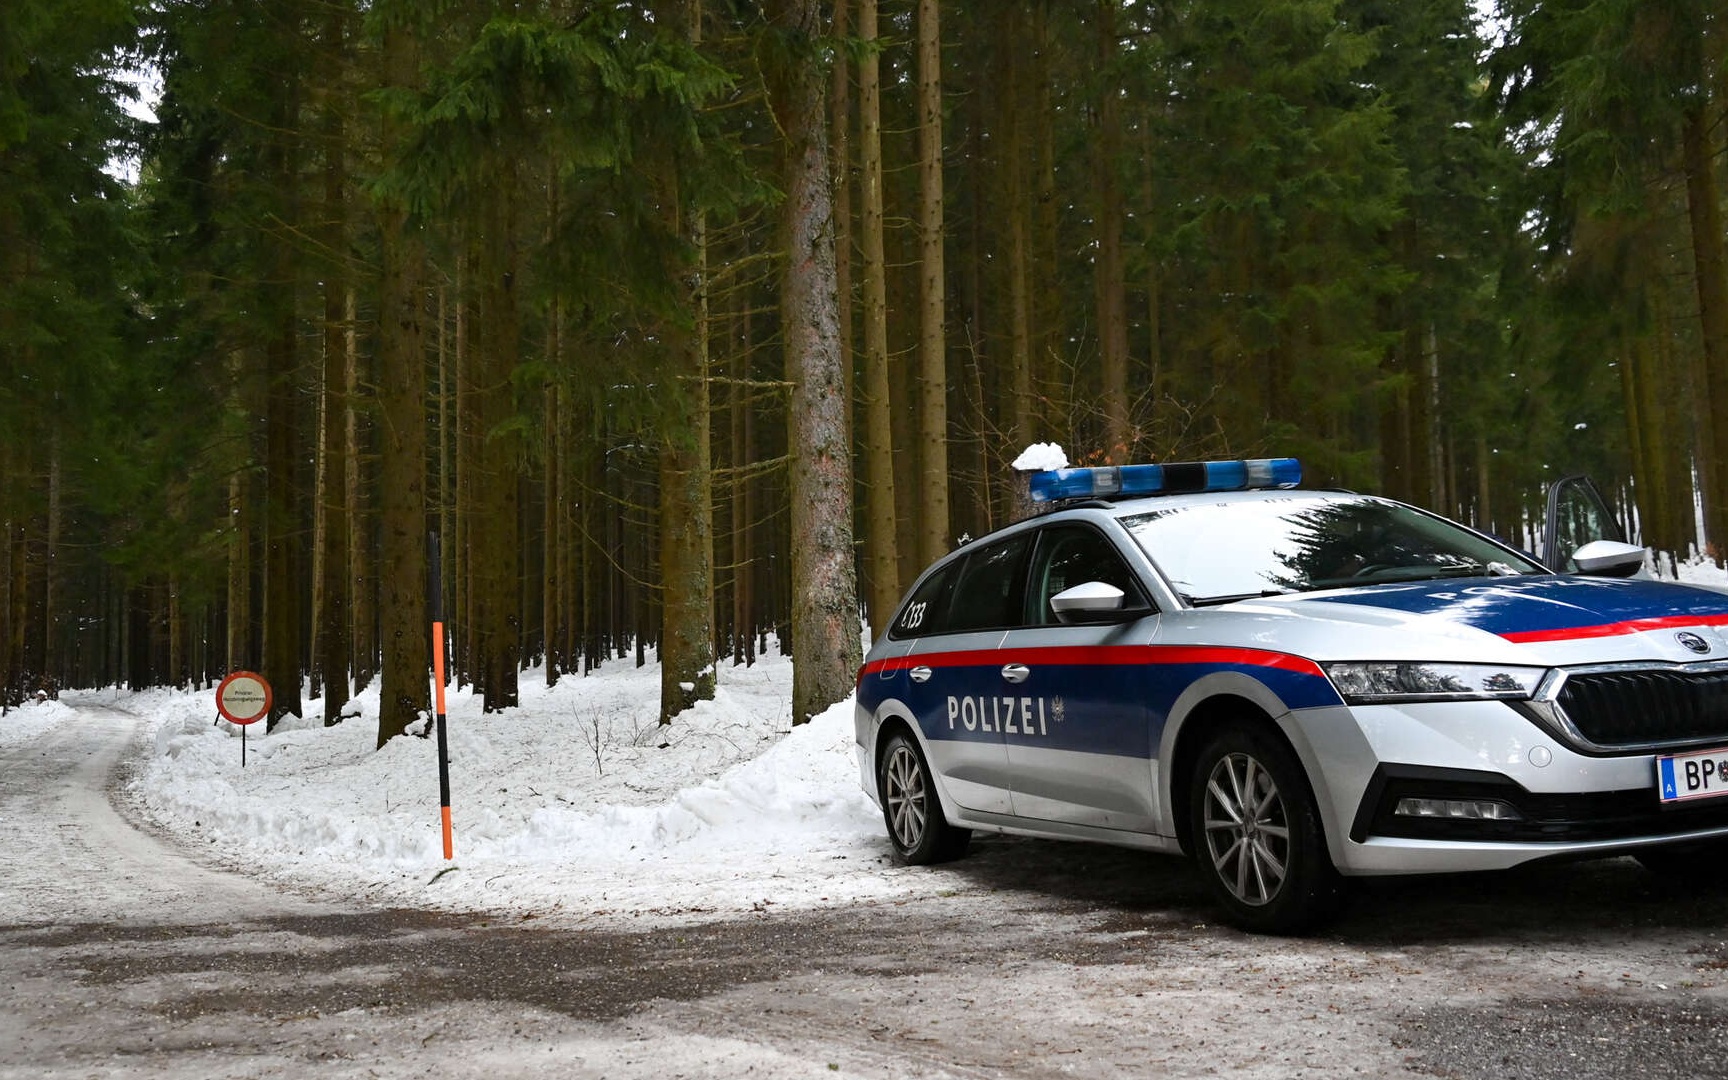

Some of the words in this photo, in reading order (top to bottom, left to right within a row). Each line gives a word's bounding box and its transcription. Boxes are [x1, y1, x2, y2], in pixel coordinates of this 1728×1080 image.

[907, 601, 927, 629] 133
[947, 695, 1047, 736] POLIZEI
[1666, 783, 1673, 793] A
[1685, 759, 1715, 791] BP
